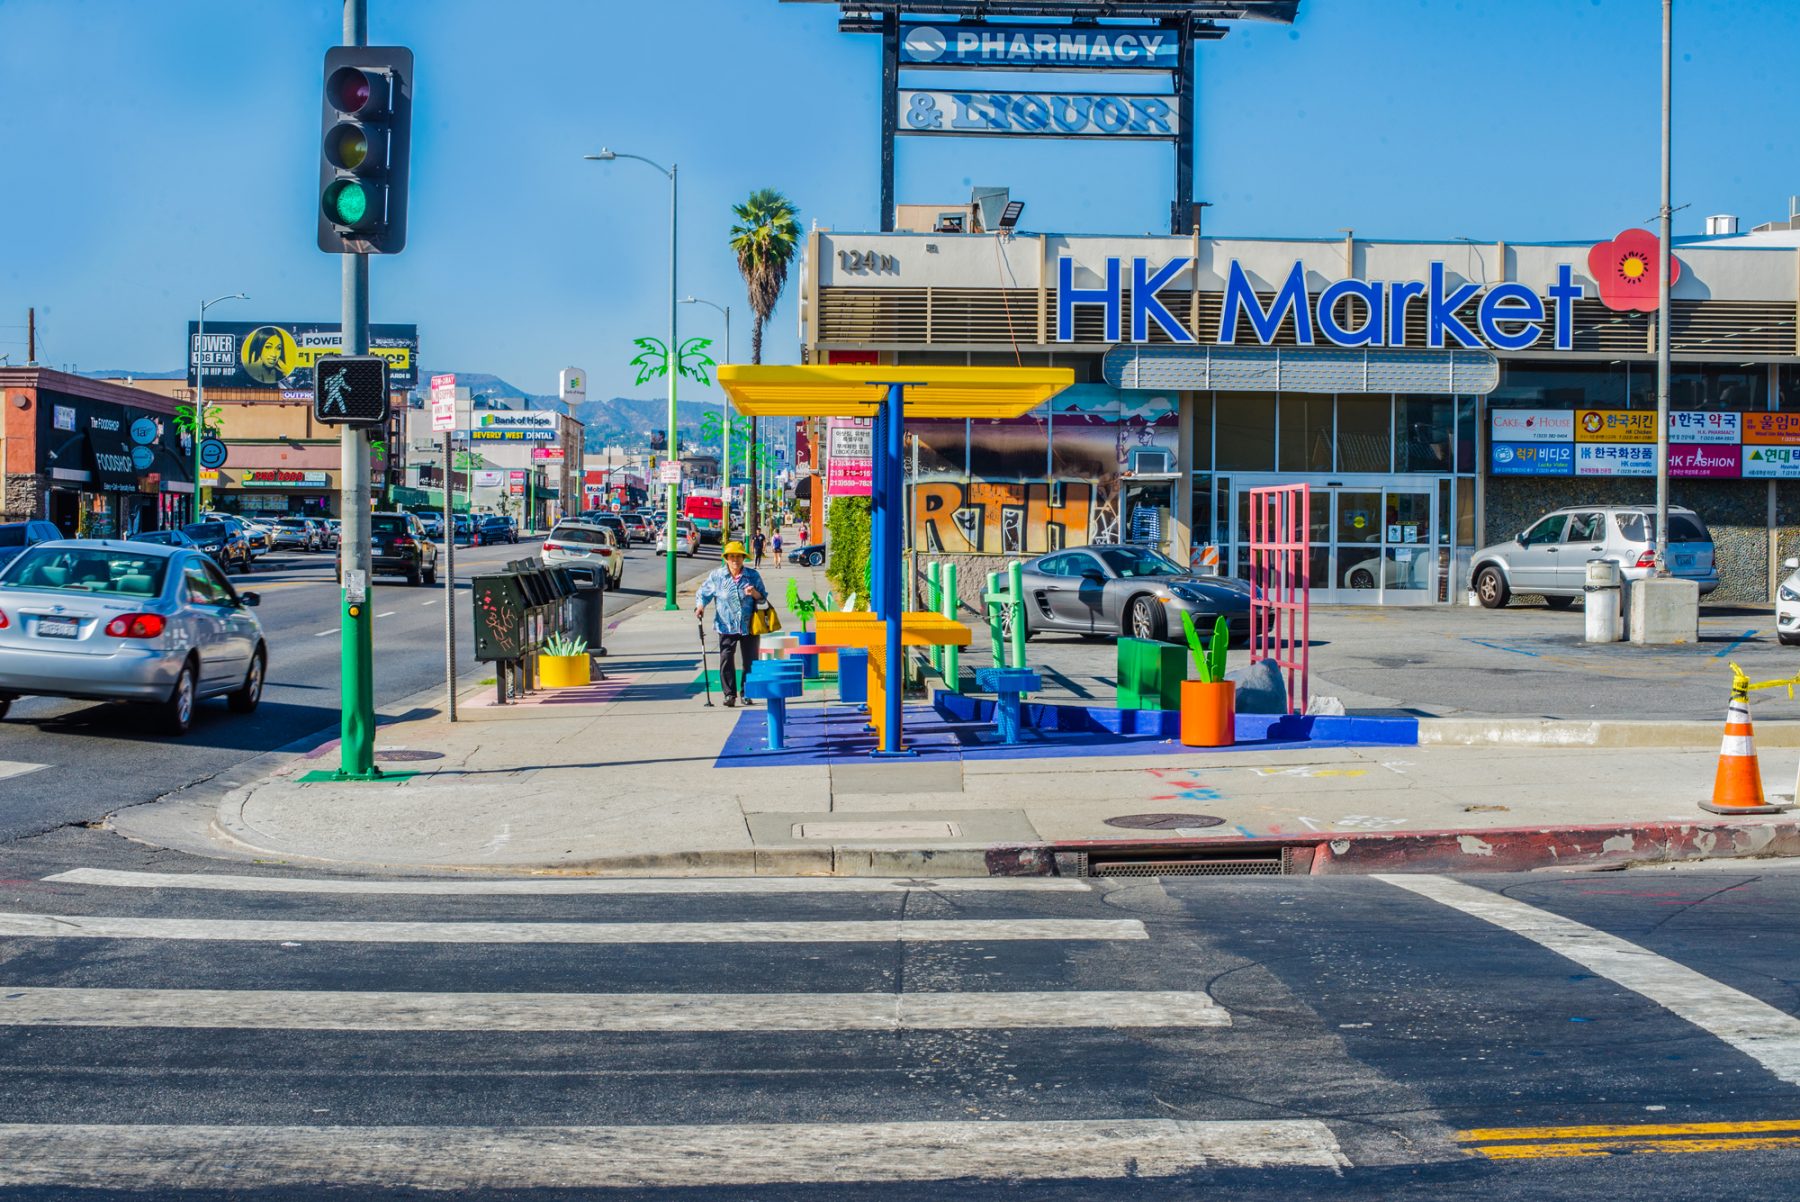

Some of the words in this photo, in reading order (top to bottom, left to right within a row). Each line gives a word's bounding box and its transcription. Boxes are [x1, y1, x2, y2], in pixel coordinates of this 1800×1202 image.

[957, 31, 1164, 62] PHARMACY
[906, 93, 943, 128] &
[951, 94, 1172, 132] LIQUOR
[838, 250, 874, 270] 124
[1056, 256, 1198, 343] HK
[1216, 258, 1585, 350] Market
[194, 336, 232, 351] POWER
[306, 337, 342, 345] POWE
[215, 353, 231, 362] FM
[222, 368, 236, 376] HOP
[495, 416, 516, 425] Bank
[517, 416, 526, 425] of
[527, 416, 550, 426] Hope
[1494, 416, 1520, 427] CAKE
[1539, 416, 1570, 427] HOUSE
[1678, 413, 1705, 428] 한국
[1709, 413, 1736, 428] 약국
[1539, 447, 1570, 461] 비디오
[1595, 447, 1653, 459] 한국화장품
[1686, 448, 1735, 467] FASHION
[96, 453, 132, 472] FOODSHOP
